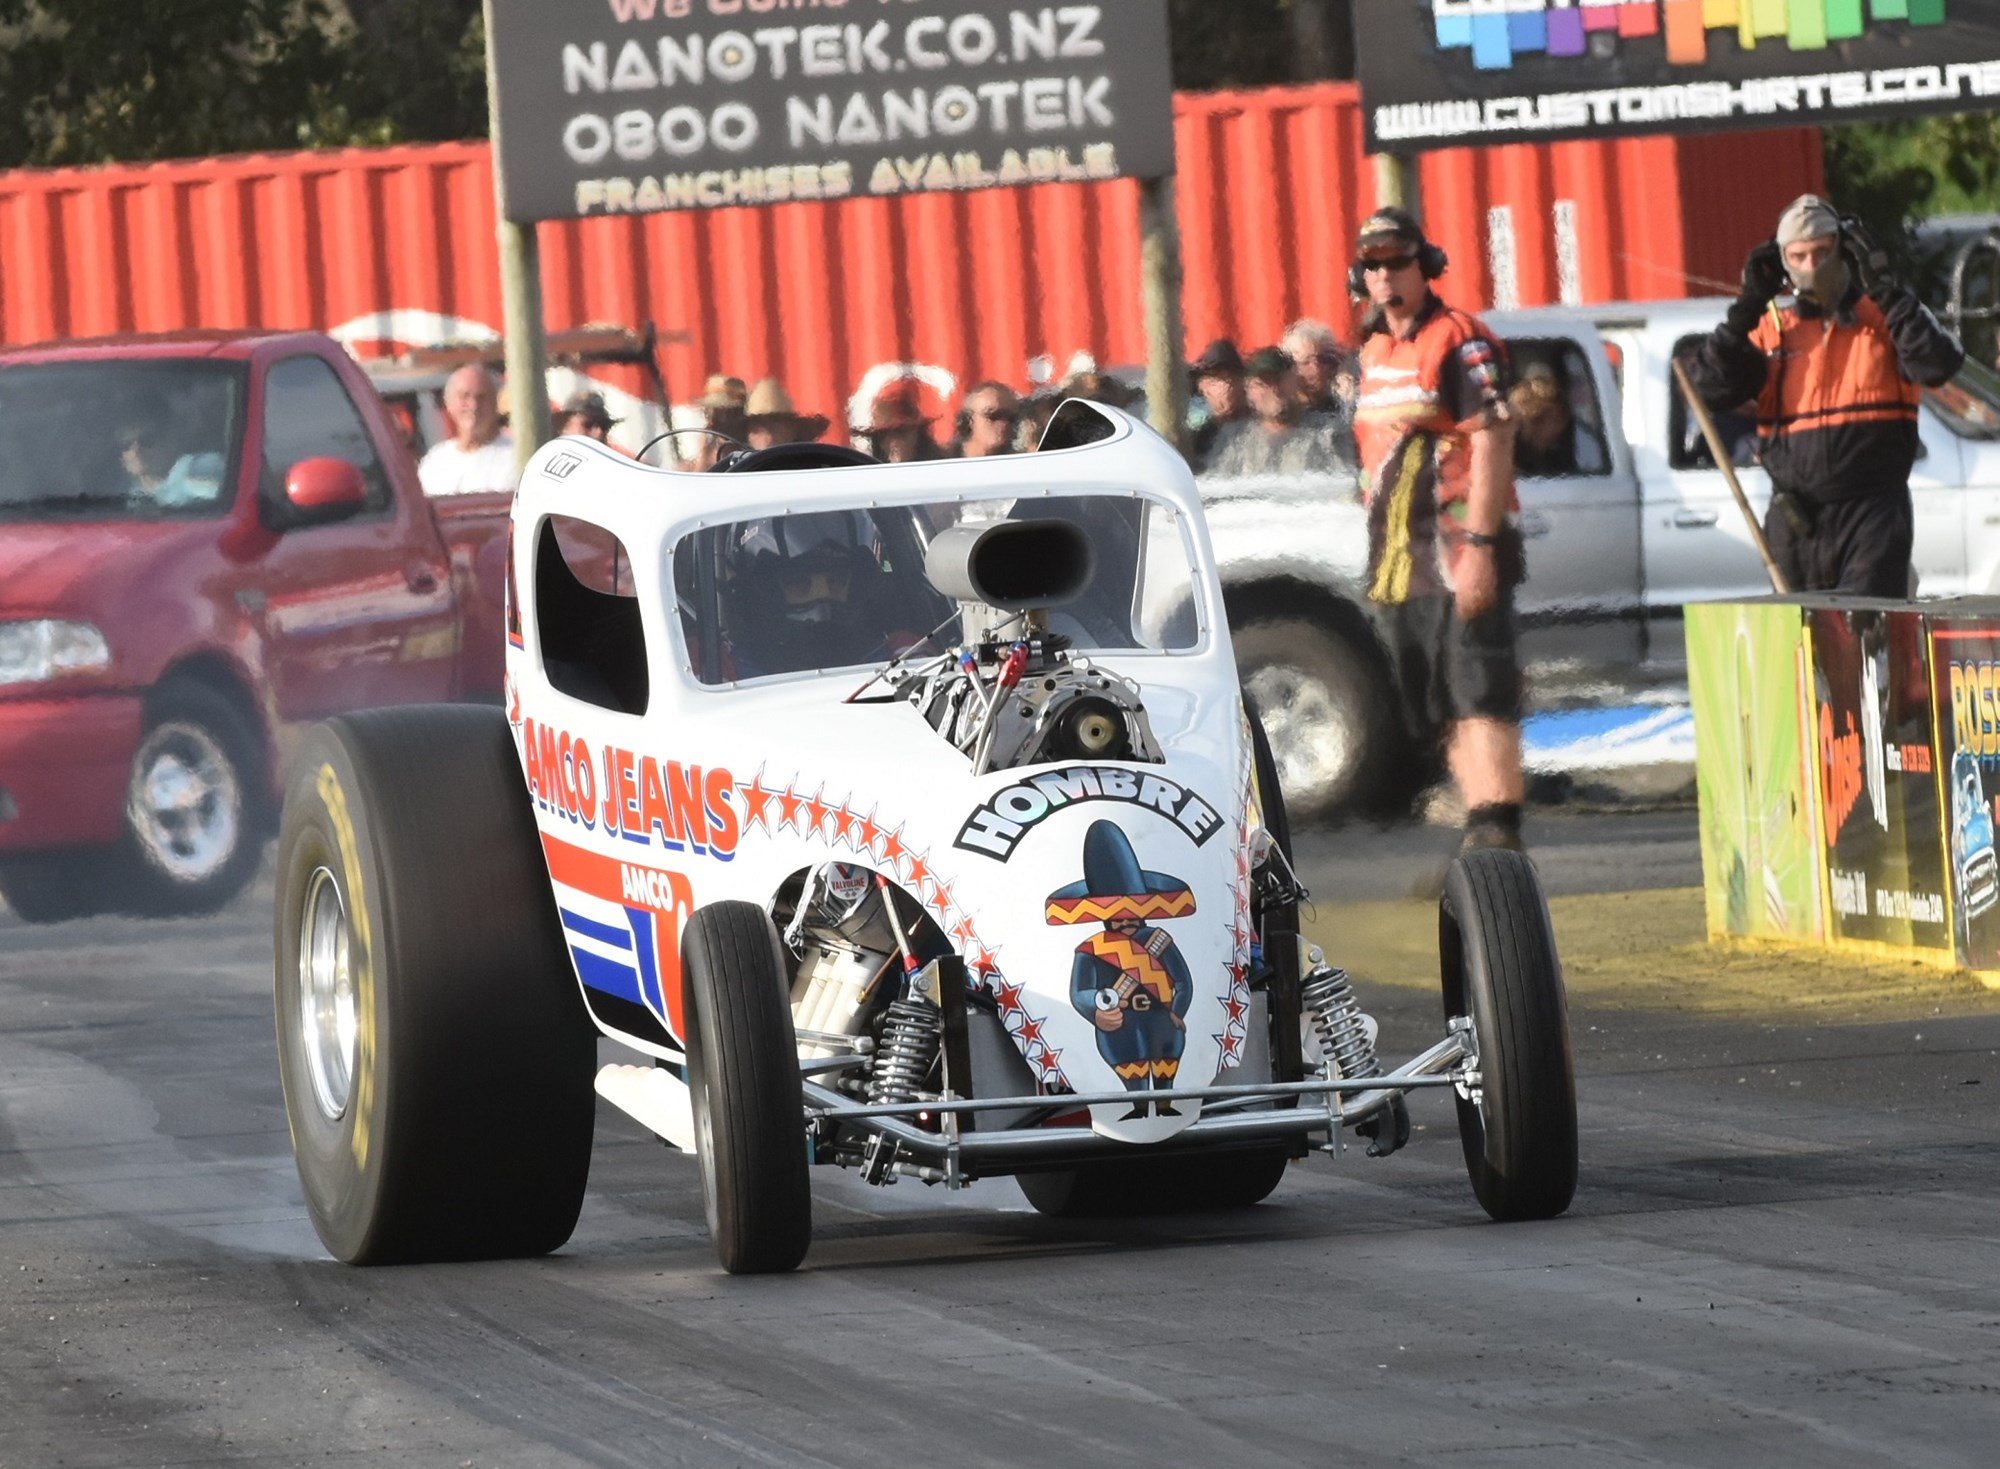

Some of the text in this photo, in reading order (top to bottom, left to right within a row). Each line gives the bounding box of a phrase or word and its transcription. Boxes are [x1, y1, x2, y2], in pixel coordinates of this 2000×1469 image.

[562, 6, 1105, 95] NANOTEK.CO.NZ
[562, 75, 1115, 164] 0800 NANOTEK
[575, 142, 1118, 215] FRANCHISES AVAILABLE
[523, 716, 743, 862] AMCO JEANS
[954, 765, 1224, 862] HOMBRE
[620, 863, 674, 913] AMCO
[831, 877, 865, 891] VALVOLINE
